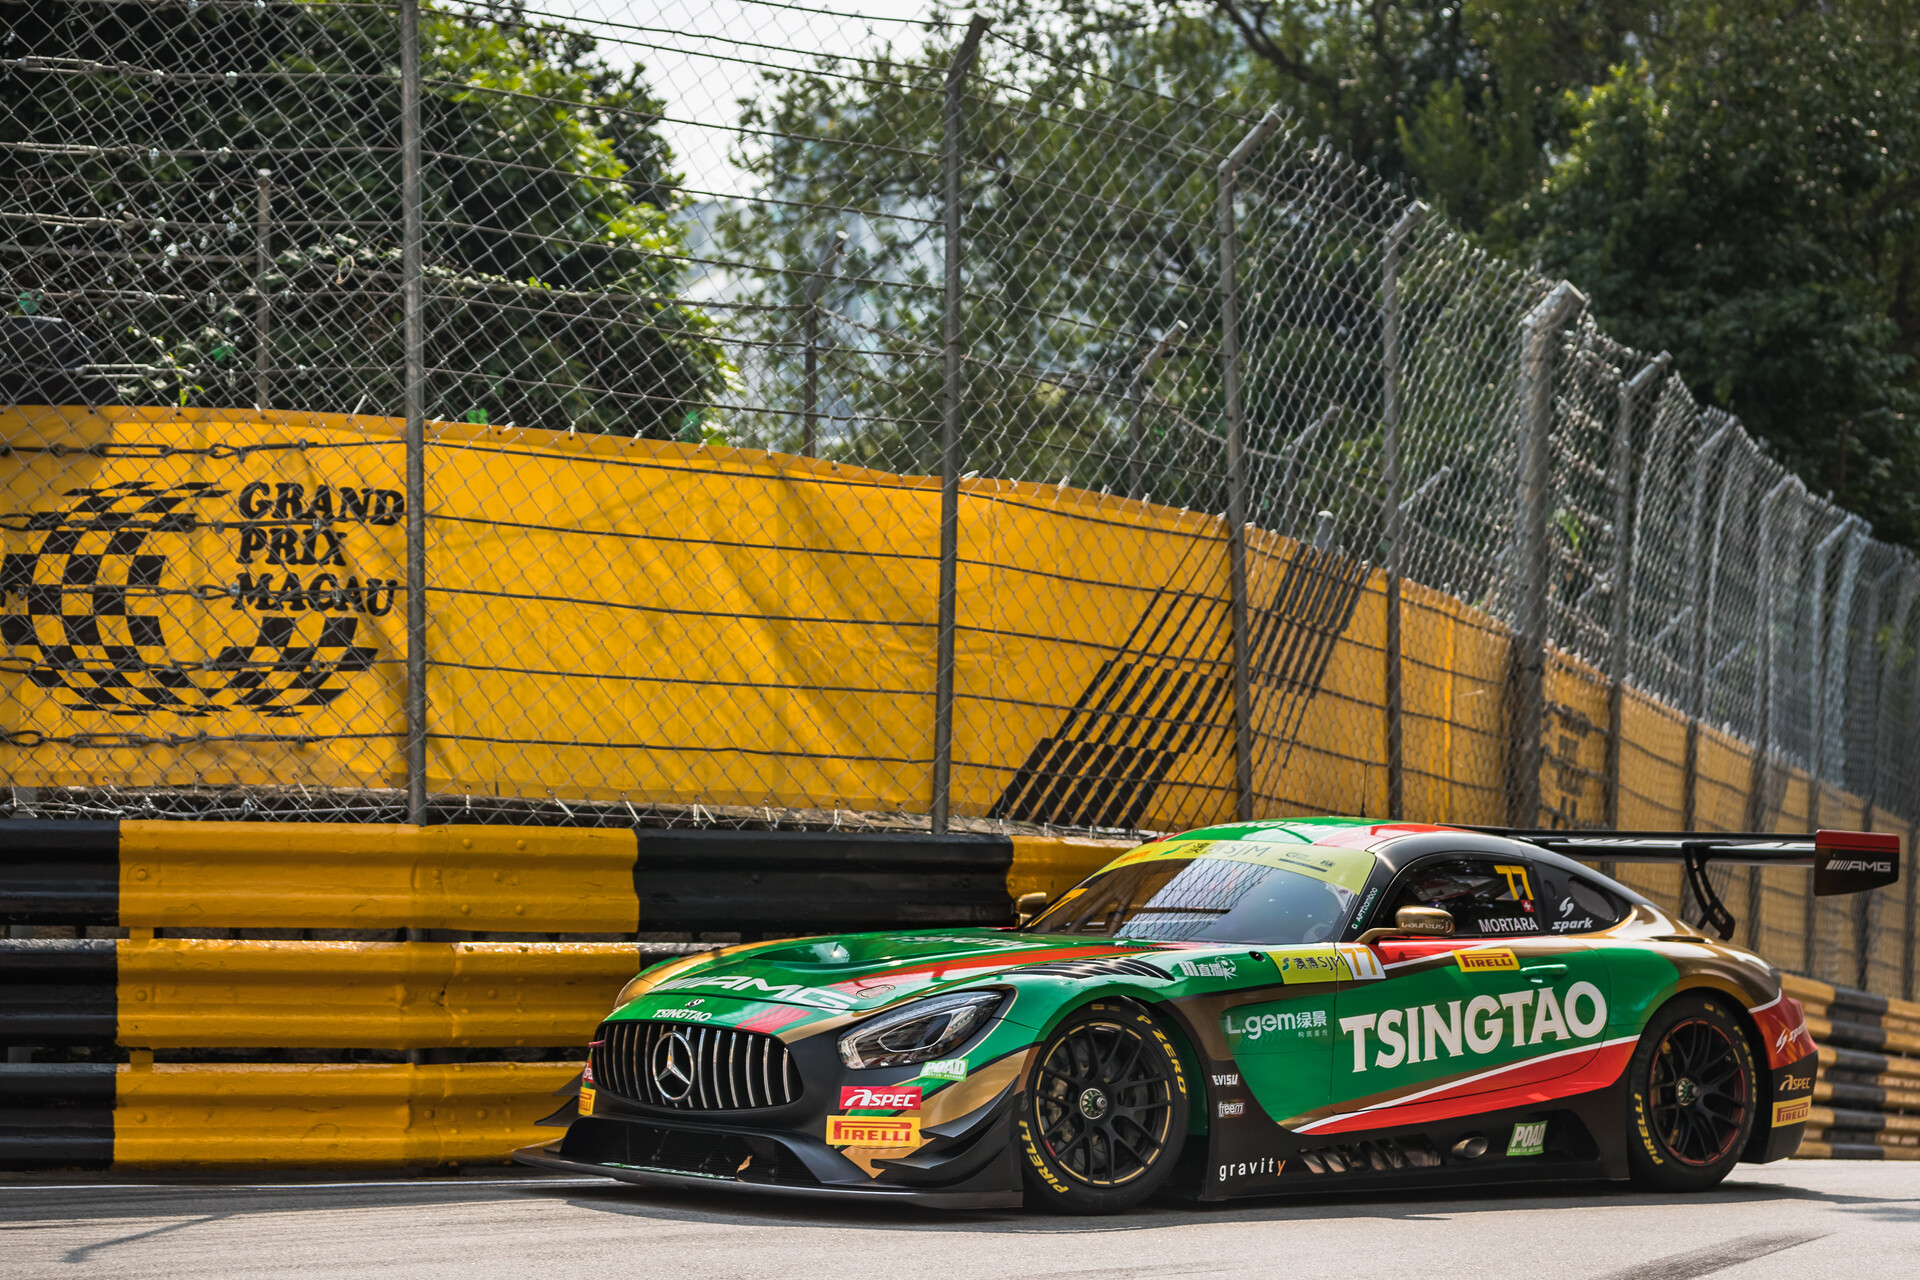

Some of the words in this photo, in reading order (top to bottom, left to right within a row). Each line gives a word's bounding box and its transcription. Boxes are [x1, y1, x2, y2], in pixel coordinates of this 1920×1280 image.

[239, 481, 405, 526] GRAND
[236, 528, 347, 566] PRIX
[231, 573, 398, 617] MACAU
[1223, 842, 1272, 858] SJM
[1846, 860, 1892, 872] AMG
[1494, 865, 1534, 900] 77
[1478, 917, 1539, 933] MORTARA
[1552, 917, 1593, 932] spark
[1317, 956, 1346, 971] SJM
[1339, 947, 1378, 976] 77
[1460, 953, 1514, 968] PIRELLI
[688, 975, 859, 1015] AMG
[652, 1008, 713, 1022] TSINGTAO
[1227, 1013, 1296, 1040] L.gem
[1339, 981, 1607, 1073] TSINGTAO
[923, 1060, 966, 1075] POAD
[1152, 1028, 1188, 1095] ZERO
[1212, 1074, 1238, 1086] EVISU
[1777, 1102, 1809, 1122] PIRELLI
[833, 1120, 912, 1141] PIRELLI
[1511, 1123, 1546, 1147] POAD
[1634, 1093, 1663, 1165] PIRELLI
[1019, 1120, 1069, 1194] PIRELLI
[1219, 1158, 1286, 1181] gravity
